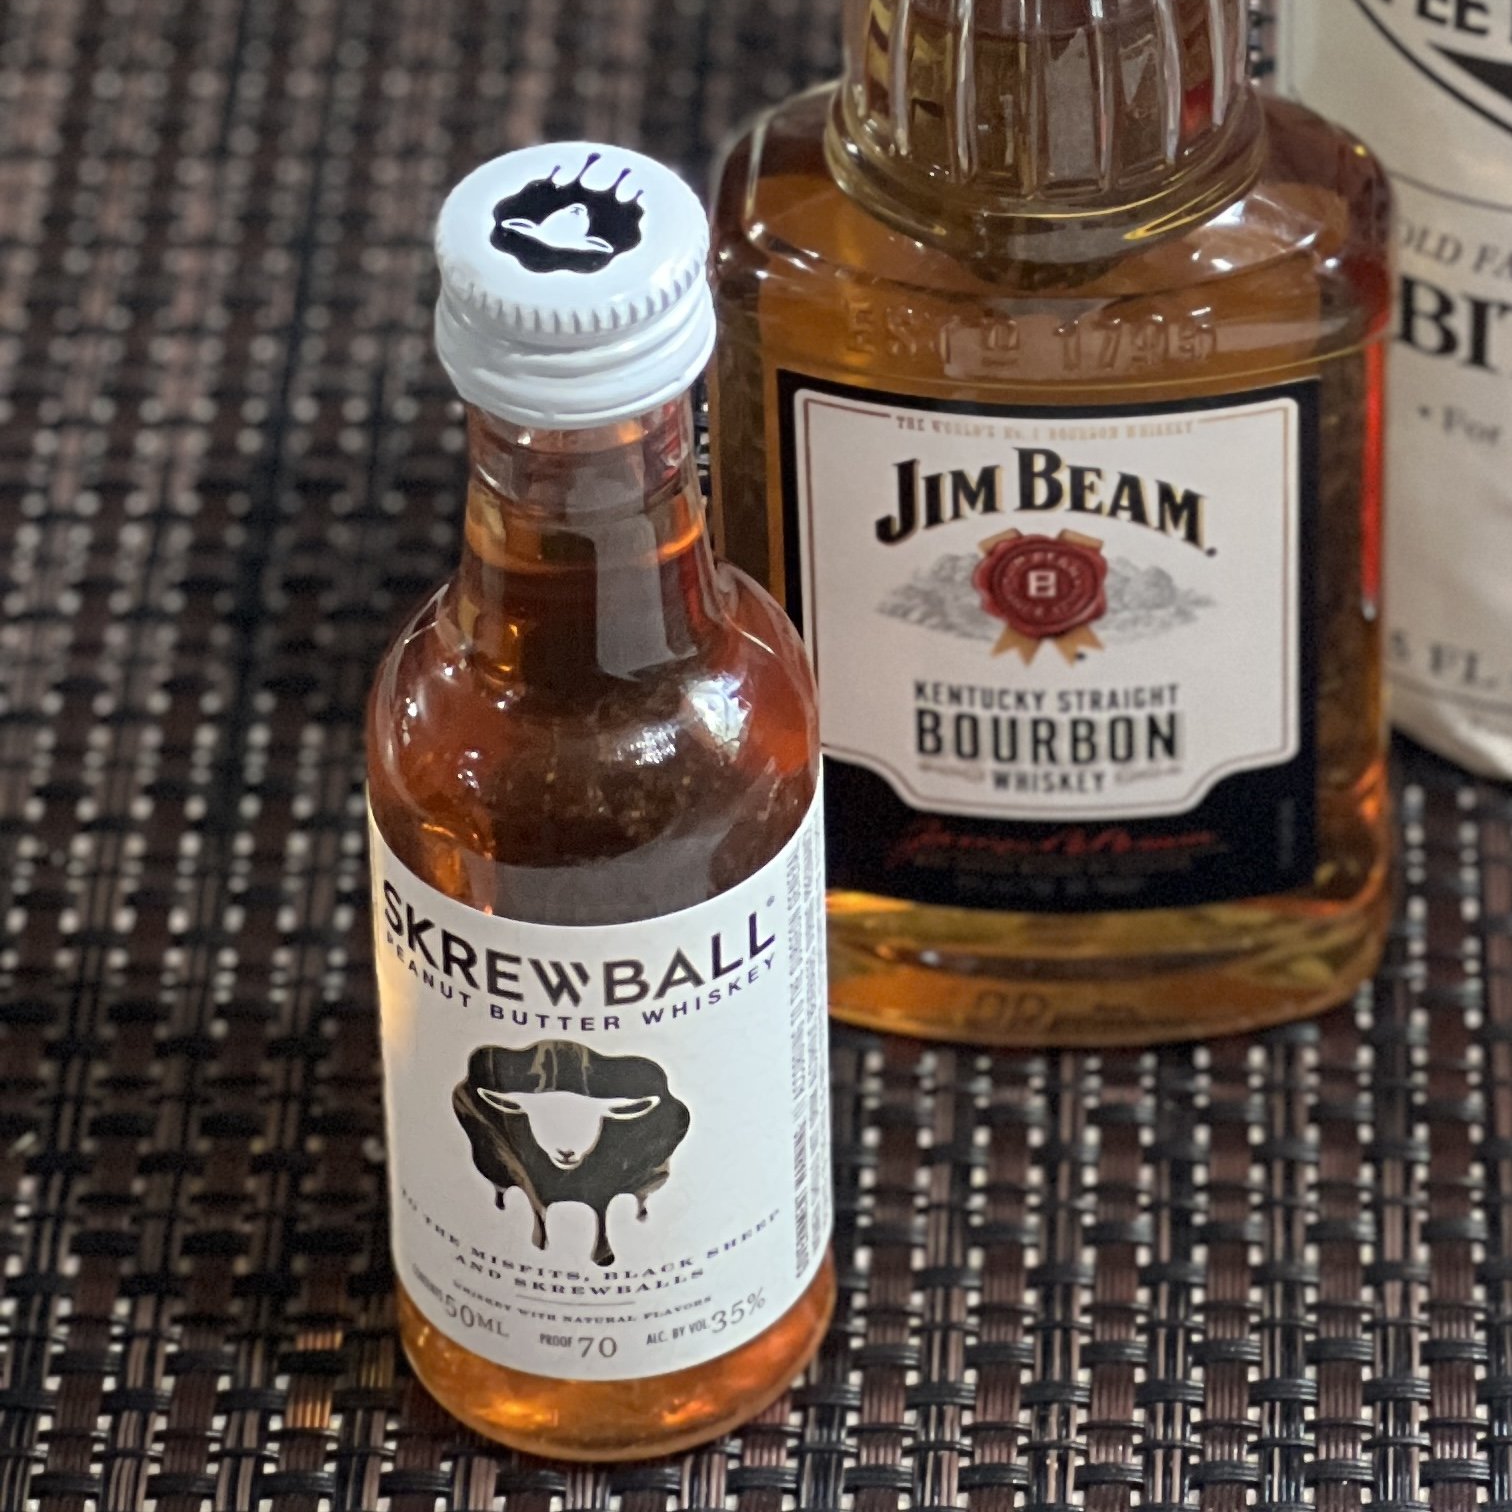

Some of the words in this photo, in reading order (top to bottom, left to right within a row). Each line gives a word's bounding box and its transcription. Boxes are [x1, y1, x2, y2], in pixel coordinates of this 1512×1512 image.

[1440, 406, 1503, 448] For
[875, 457, 1002, 546] JIM
[1012, 447, 1210, 555] BEAM
[914, 679, 1046, 713] KENTUCKY
[1056, 682, 1180, 713] STRAIGHT
[915, 707, 1179, 766] BOURBON
[991, 769, 1106, 793] WHISKEY
[383, 878, 776, 1008] SKREWBALL
[490, 1003, 620, 1031] BUTTER
[642, 953, 775, 1025] WHISKEY
[604, 1258, 694, 1280] BLACK
[706, 1208, 780, 1259] SHEEP
[453, 1278, 512, 1312] WHISKEY
[516, 1307, 556, 1322] WITH
[563, 1315, 637, 1324] NATURAL
[643, 1295, 712, 1320] FLAVORS
[455, 1253, 503, 1280] AND
[514, 1267, 704, 1295] SKREWBALLS
[444, 1294, 510, 1338] 50ML
[539, 1333, 572, 1348] PROOF
[577, 1336, 618, 1359] 70
[672, 1325, 685, 1340] BY
[711, 1286, 767, 1334] 35%
